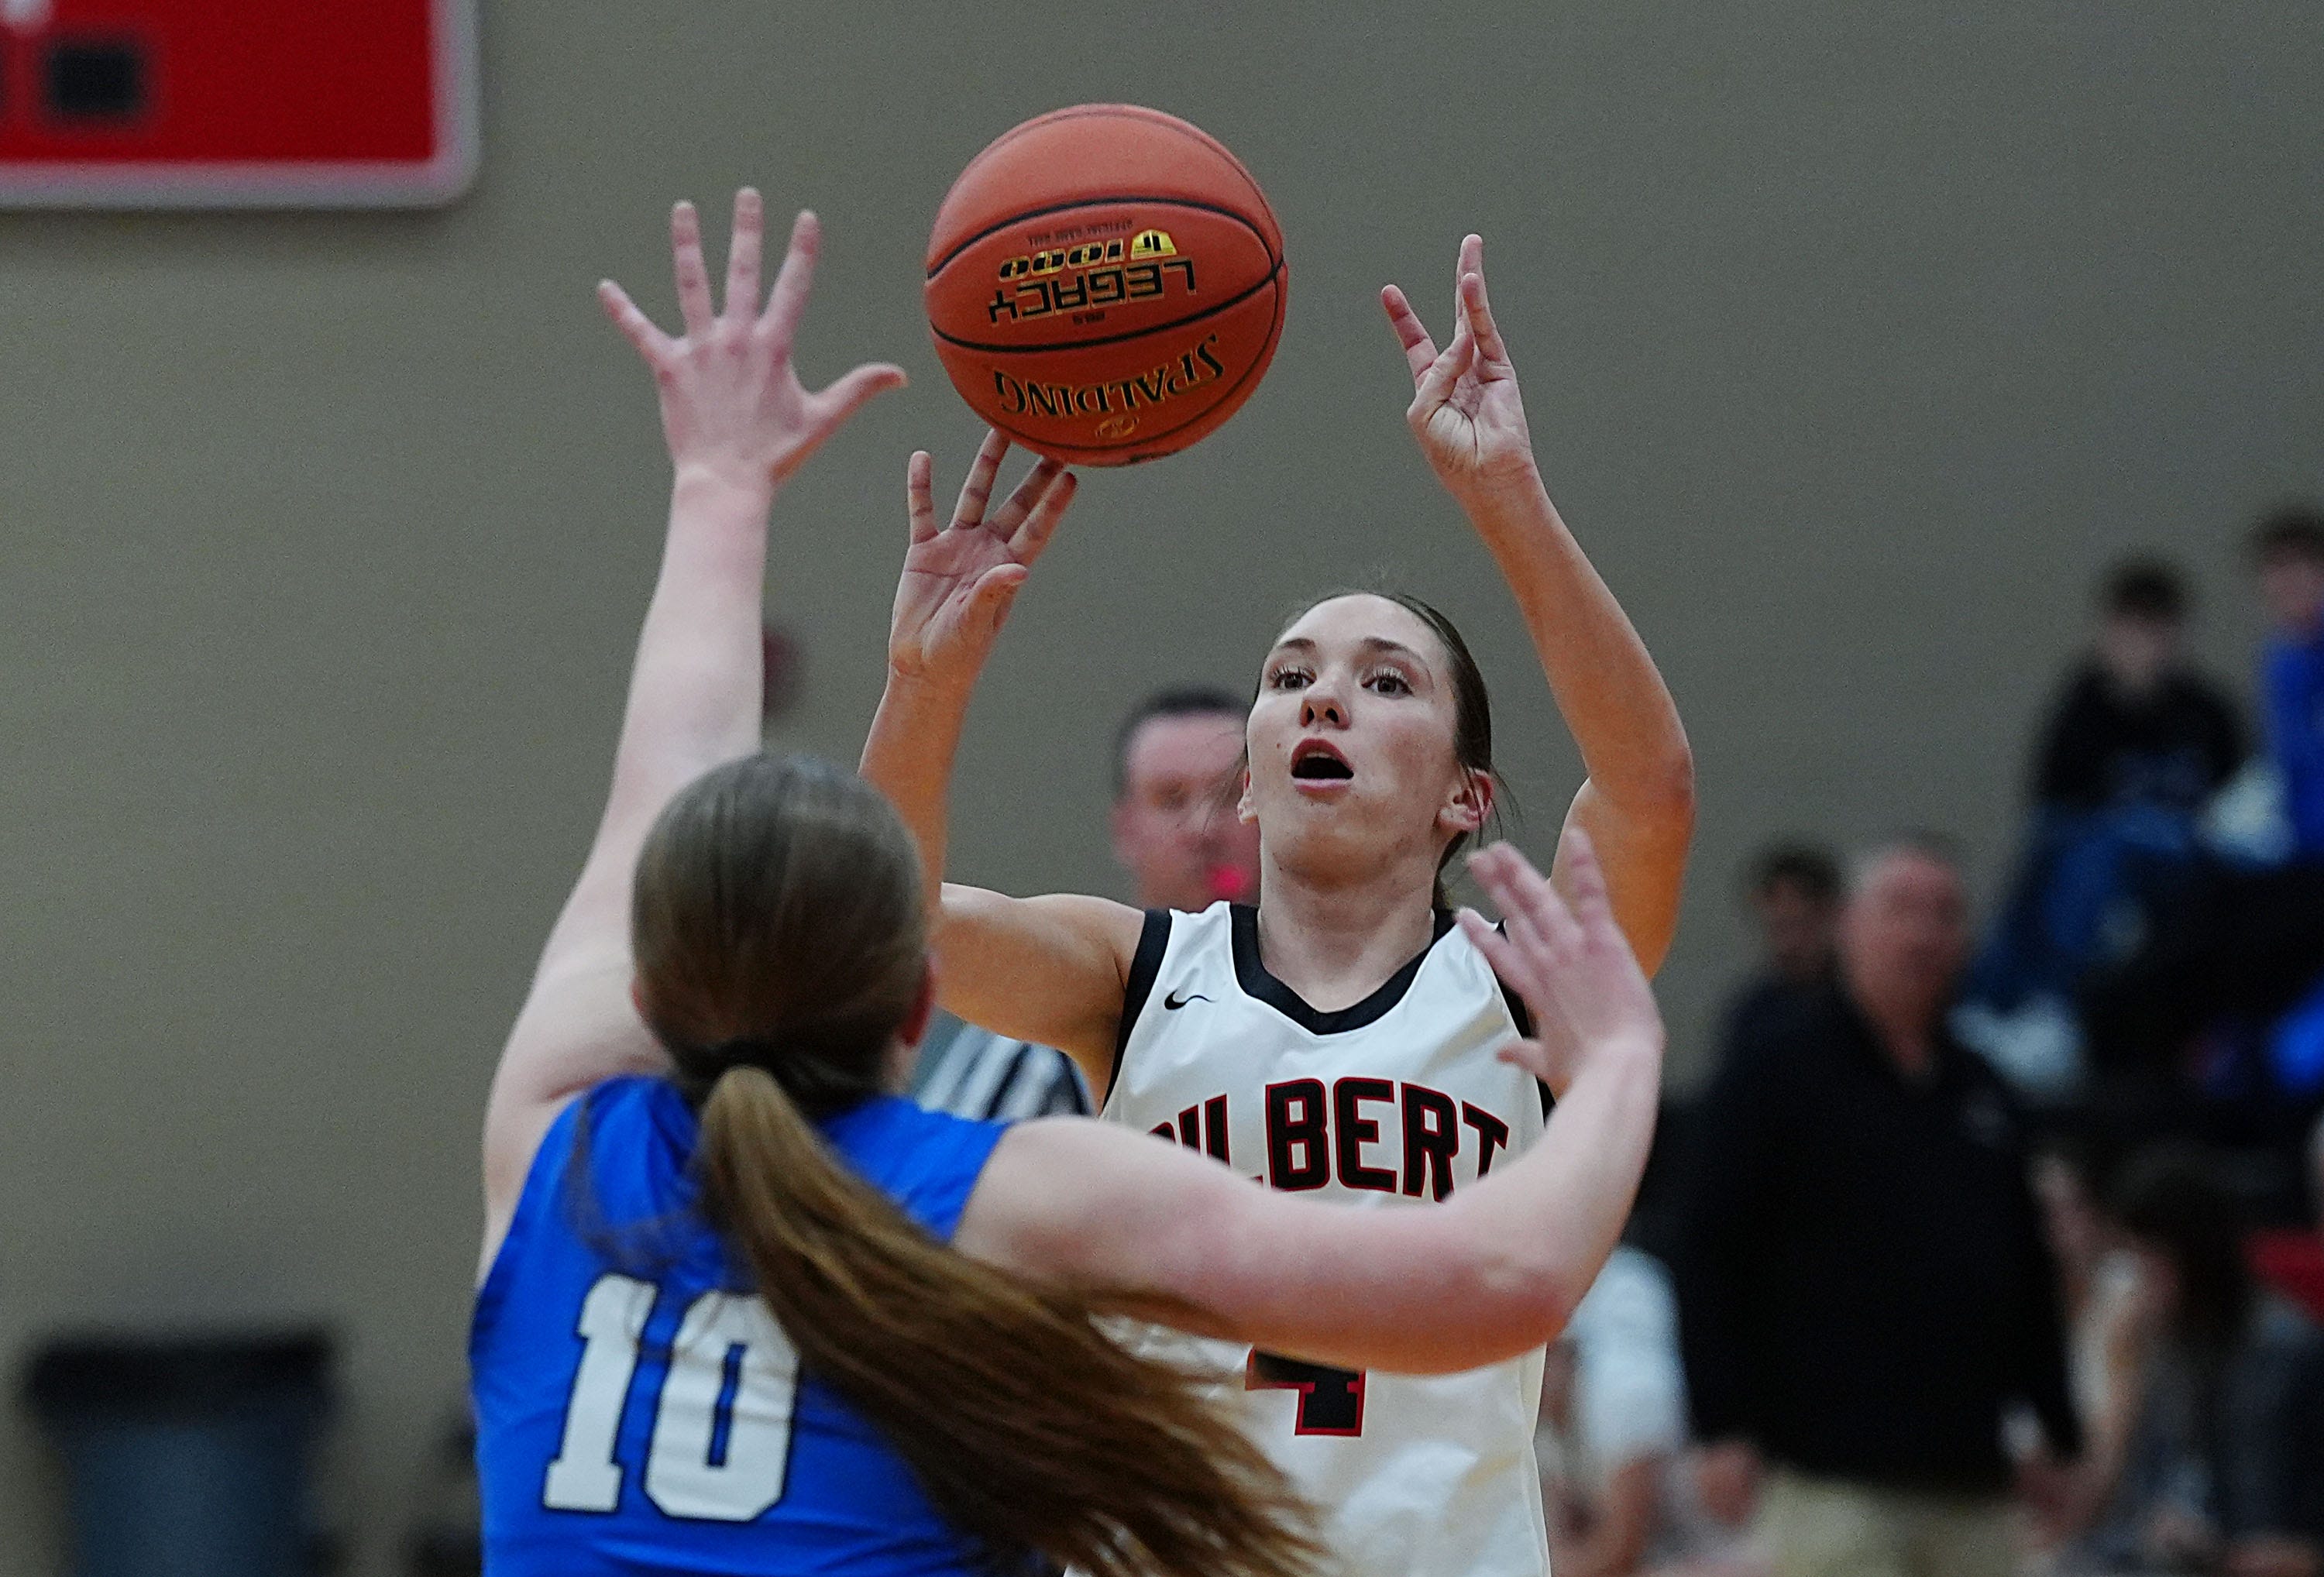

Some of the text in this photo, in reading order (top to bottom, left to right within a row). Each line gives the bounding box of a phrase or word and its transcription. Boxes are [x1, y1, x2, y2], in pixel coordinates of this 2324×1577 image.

[988, 257, 1198, 326] LEGACY
[998, 238, 1126, 281] 1000
[992, 332, 1225, 417] SPALDING
[1149, 1077, 1509, 1203] LBERT
[544, 1273, 799, 1522] 10
